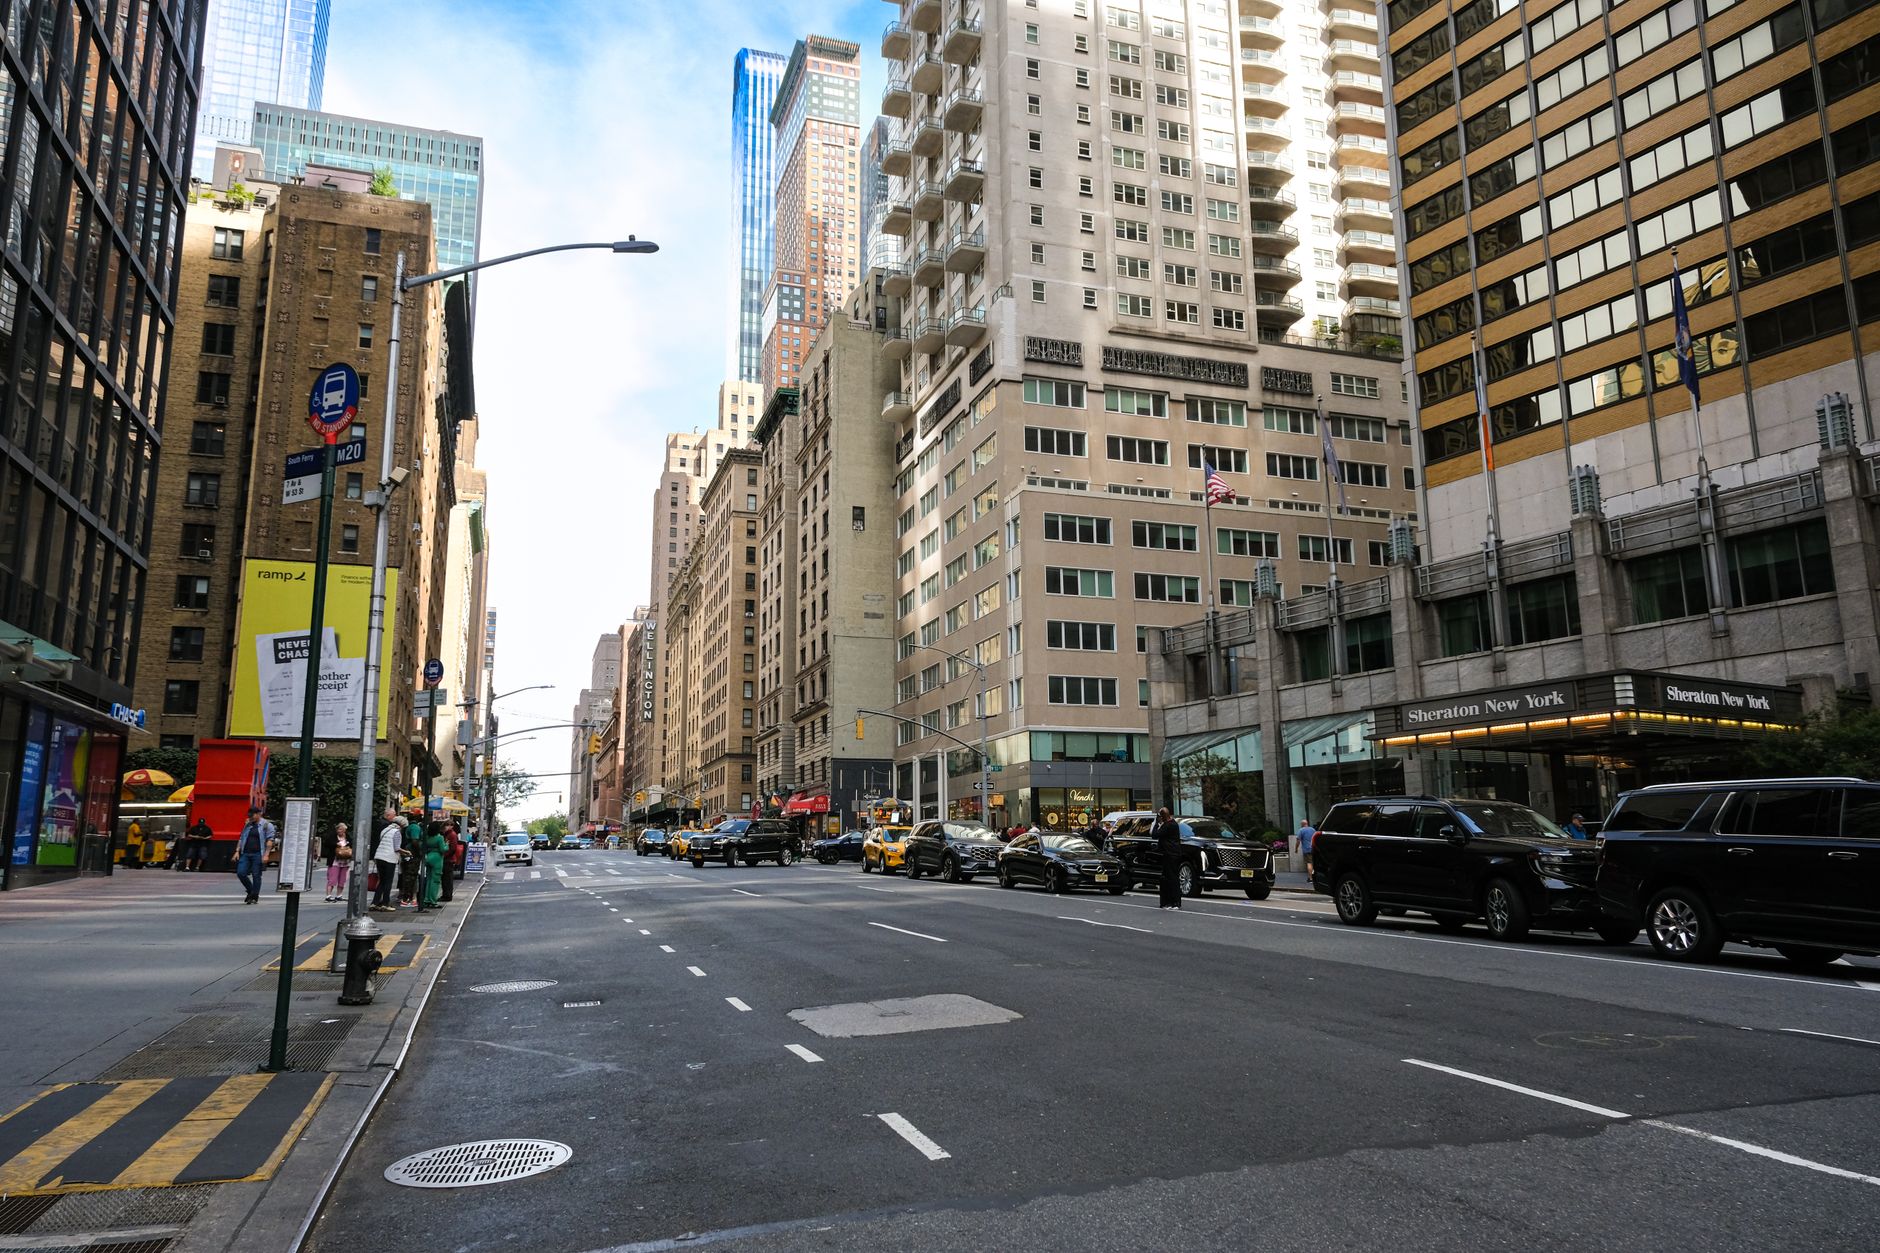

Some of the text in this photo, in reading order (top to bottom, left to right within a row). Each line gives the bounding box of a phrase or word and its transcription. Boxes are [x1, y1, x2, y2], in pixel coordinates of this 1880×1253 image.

[312, 411, 353, 433] NO STANDING
[288, 454, 314, 465] South Ferry
[337, 443, 361, 462] M20
[258, 570, 293, 582] ramp
[277, 640, 310, 650] NEVE
[278, 650, 310, 659] CHAS
[644, 622, 656, 719] WELLINGTON
[317, 681, 348, 691] eceipt
[1666, 685, 1770, 709] Sheraton New York
[1408, 690, 1565, 723] Sheraton New York
[112, 703, 138, 726] CHASE
[1069, 789, 1095, 801] Venchi
